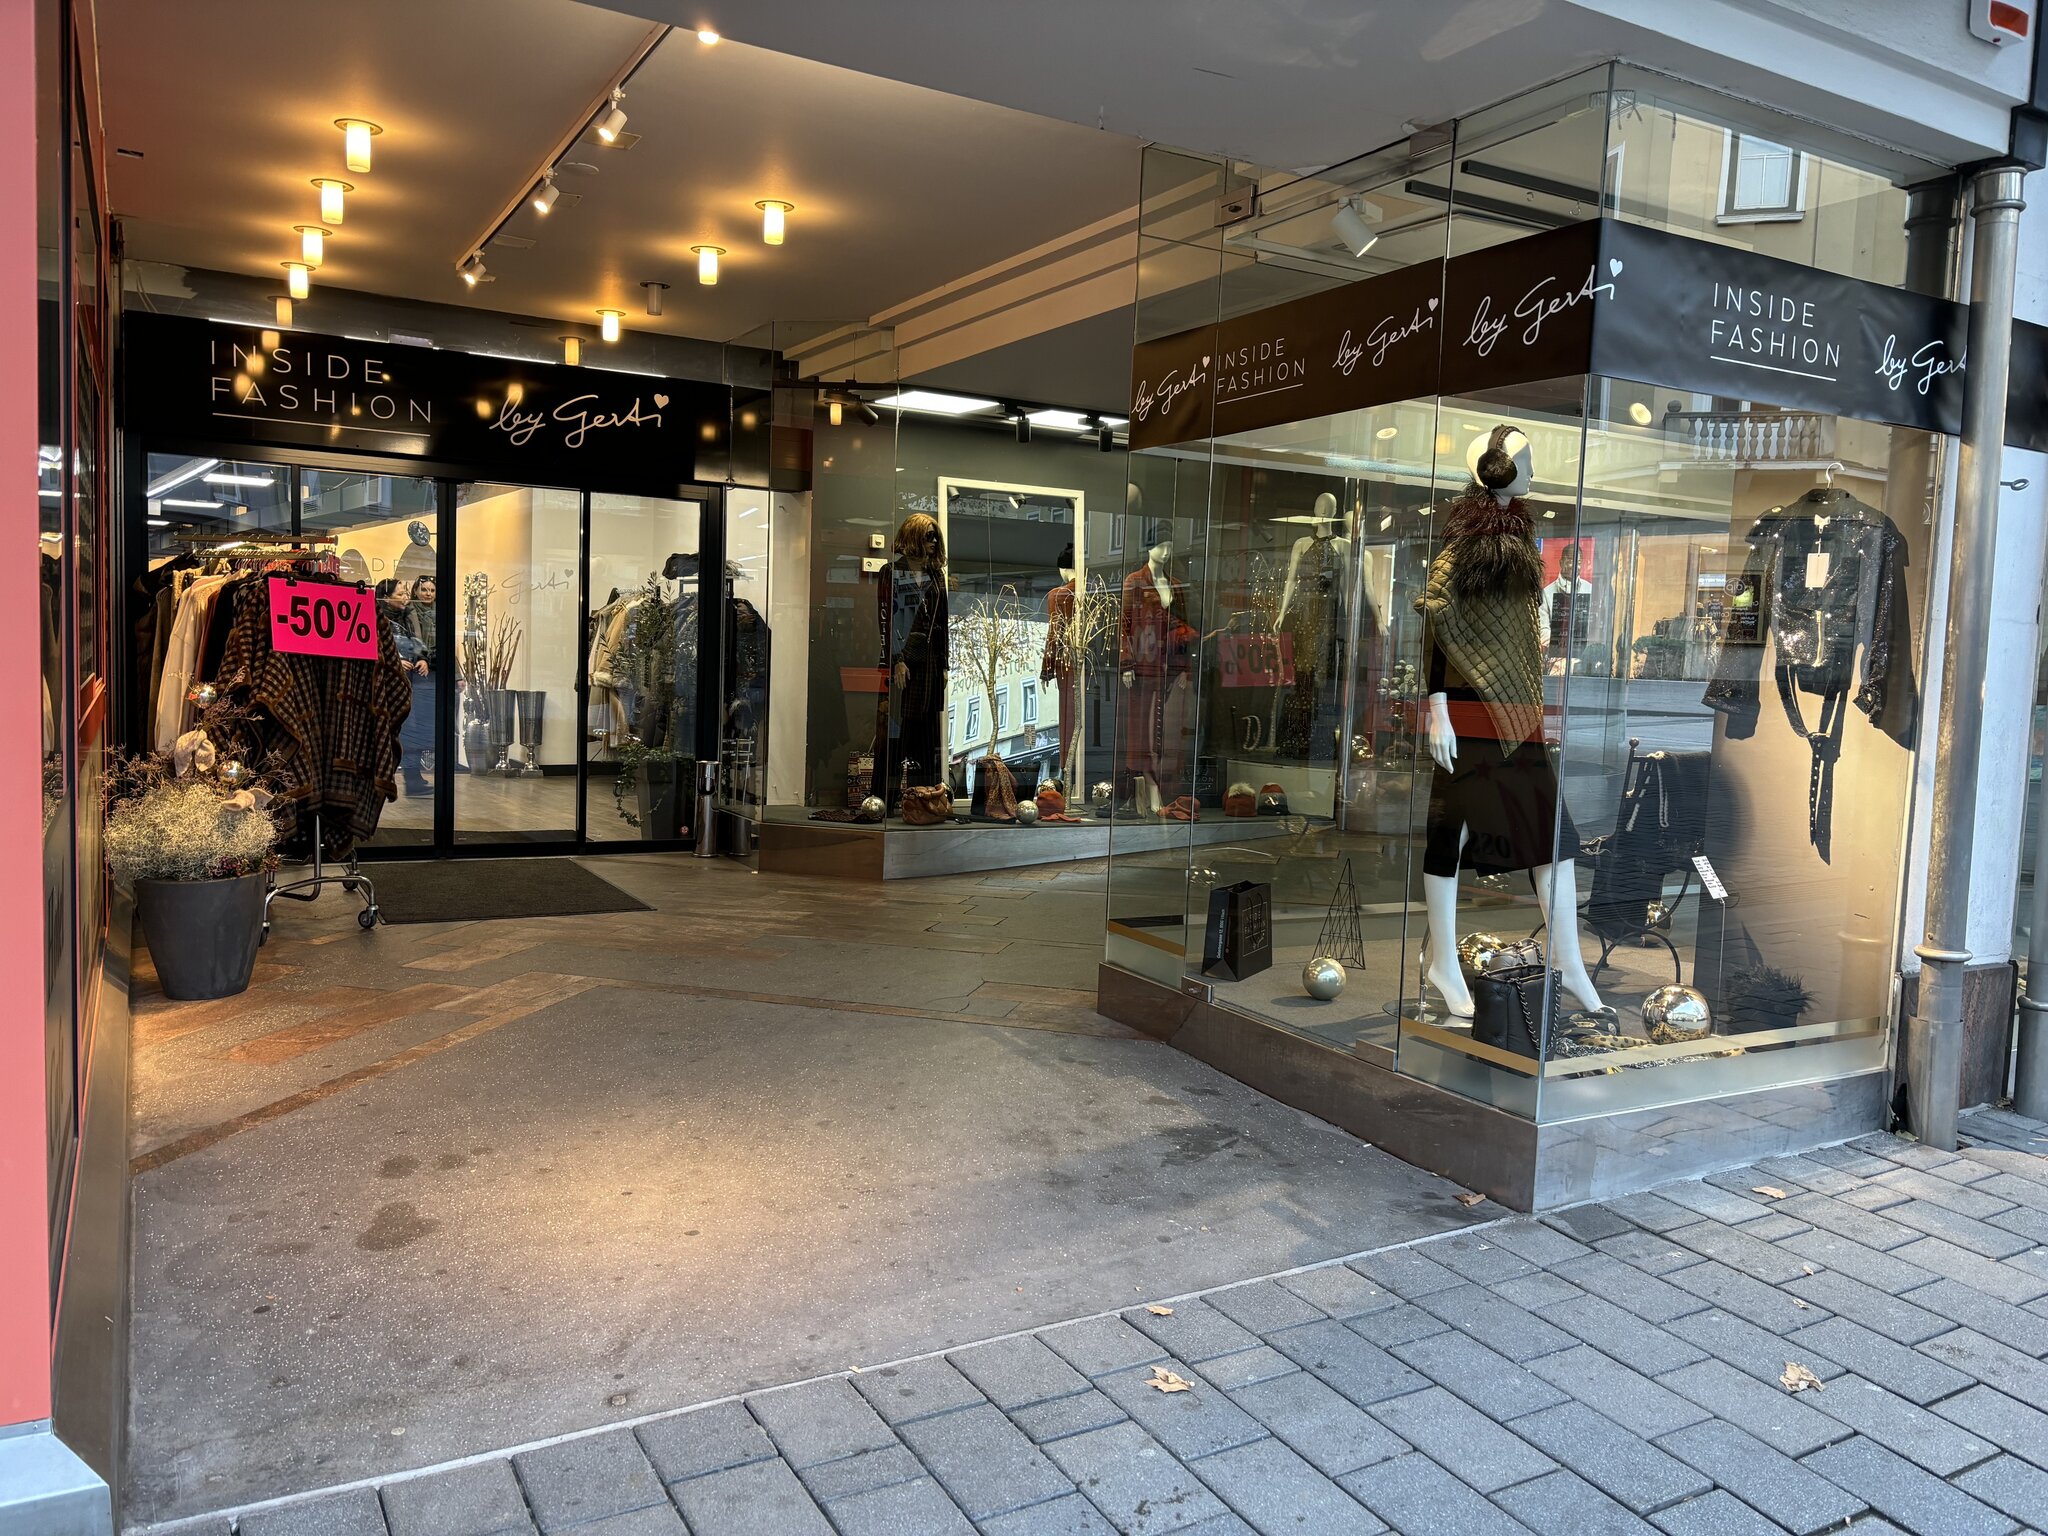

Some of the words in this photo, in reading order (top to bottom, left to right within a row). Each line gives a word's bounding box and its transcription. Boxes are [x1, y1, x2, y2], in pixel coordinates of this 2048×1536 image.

[1463, 295, 1509, 357] by
[1513, 258, 1624, 346] Gerti
[1712, 281, 1816, 329] INSIDE
[210, 340, 387, 385] INSIDE
[1215, 336, 1287, 373] INSIDE
[1332, 330, 1363, 377] by
[1366, 297, 1440, 368] Gerti
[1710, 319, 1841, 369] FASHION
[1874, 333, 1909, 391] by
[1911, 340, 1968, 395] Gert
[1131, 380, 1156, 422] by
[1156, 355, 1212, 416] Gerti
[1215, 357, 1307, 396] FASHION
[210, 376, 434, 424] FASHION
[489, 388, 547, 446] by
[552, 393, 670, 449] Gerti
[275, 594, 371, 645] -50%
